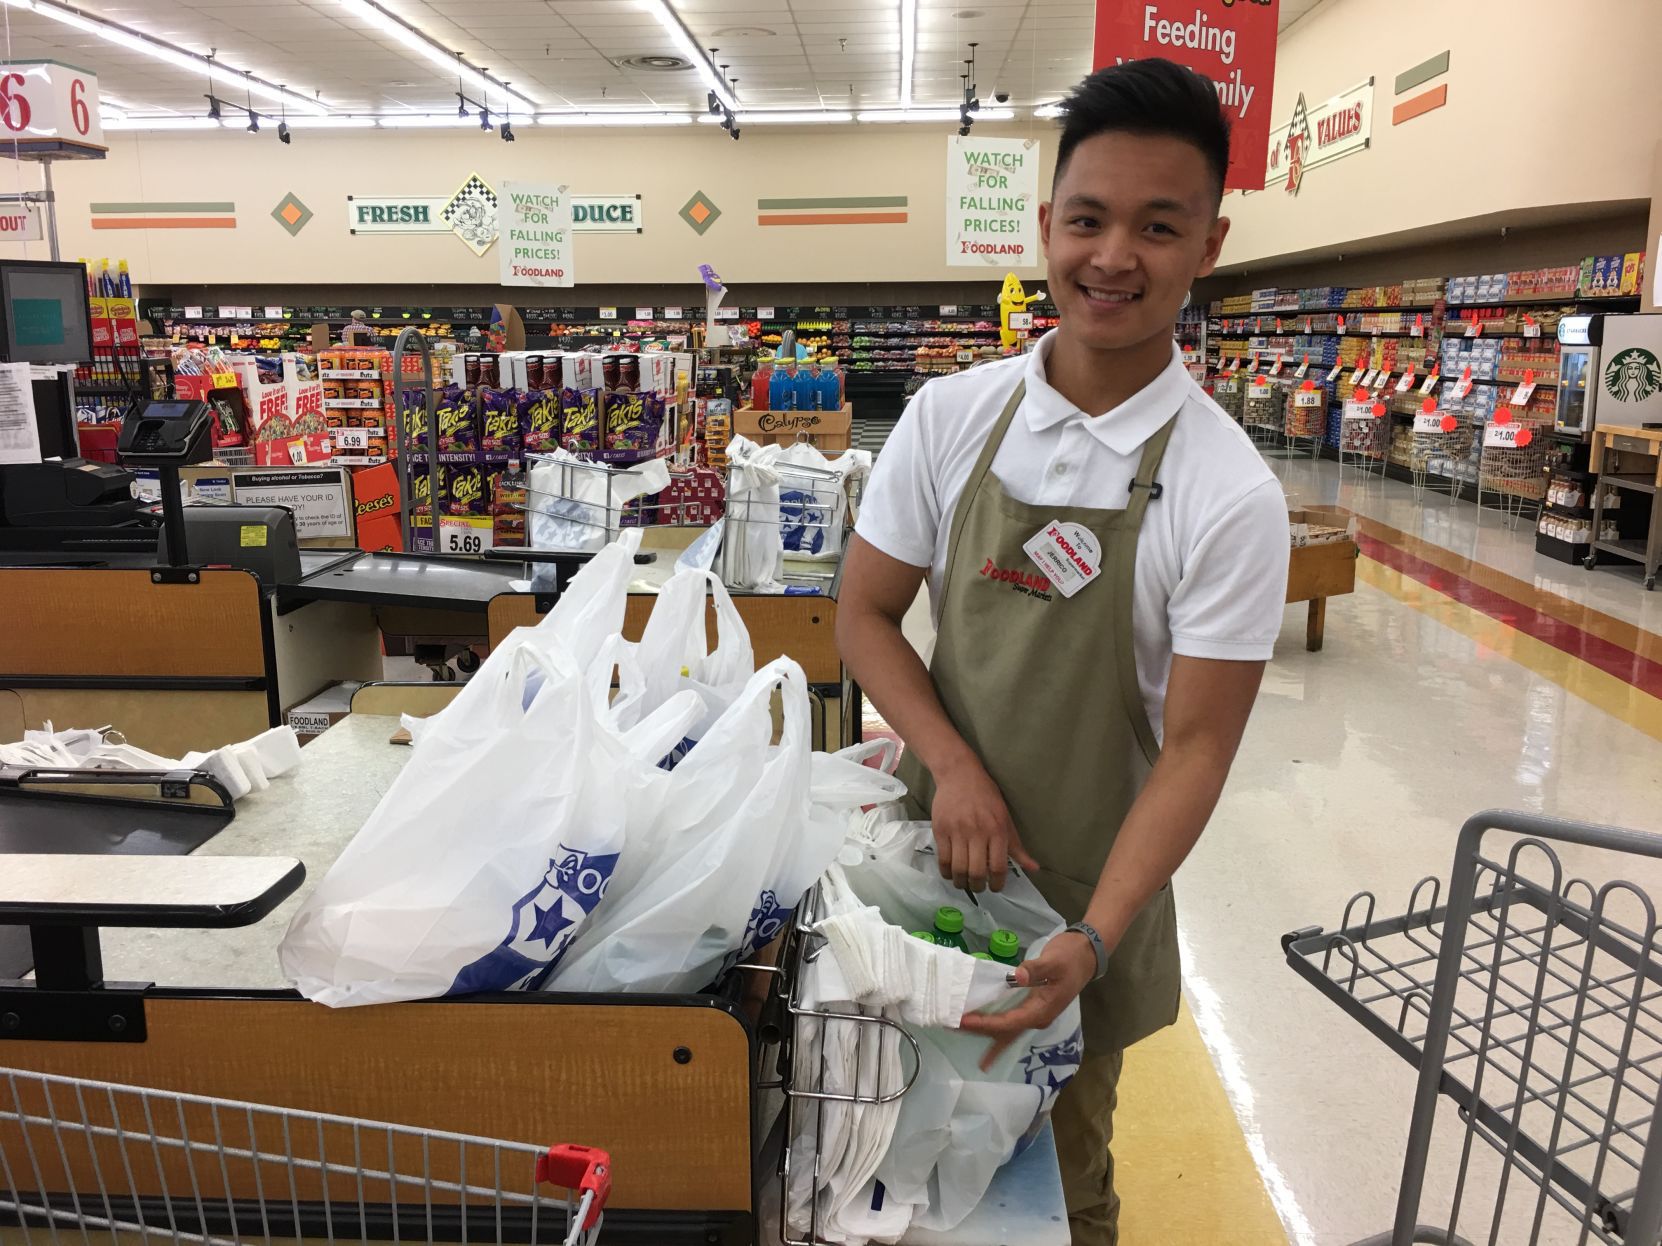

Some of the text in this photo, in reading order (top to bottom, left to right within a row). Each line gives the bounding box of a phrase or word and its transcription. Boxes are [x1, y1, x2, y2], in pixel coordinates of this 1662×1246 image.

[1143, 5, 1236, 65] Feeding
[0, 73, 31, 132] 6
[70, 78, 90, 136] 6
[1317, 101, 1362, 149] VALUES
[964, 151, 1023, 168] WATCH
[978, 174, 1008, 189] FOR
[511, 193, 559, 208] WATCH
[960, 196, 1025, 212] FALLING
[357, 204, 430, 224] FRESH
[524, 212, 549, 225] FOR
[964, 219, 1020, 233] PRICES!
[510, 229, 563, 243] FALLING
[514, 247, 561, 260] PRICES!
[960, 240, 1024, 255] FOODLAND
[512, 265, 564, 278] FOODLAND
[606, 399, 644, 434] Takis
[758, 413, 821, 432] Calypso
[343, 436, 361, 446] 6.99
[439, 453, 476, 463] INTENSITY!
[246, 493, 334, 504] PLEASE HAVE YOUR ID
[449, 534, 481, 553] 5.69
[1047, 526, 1093, 576] FOODLAND
[980, 558, 1051, 592] FOODLAND
[290, 716, 329, 726] FOODLAND
